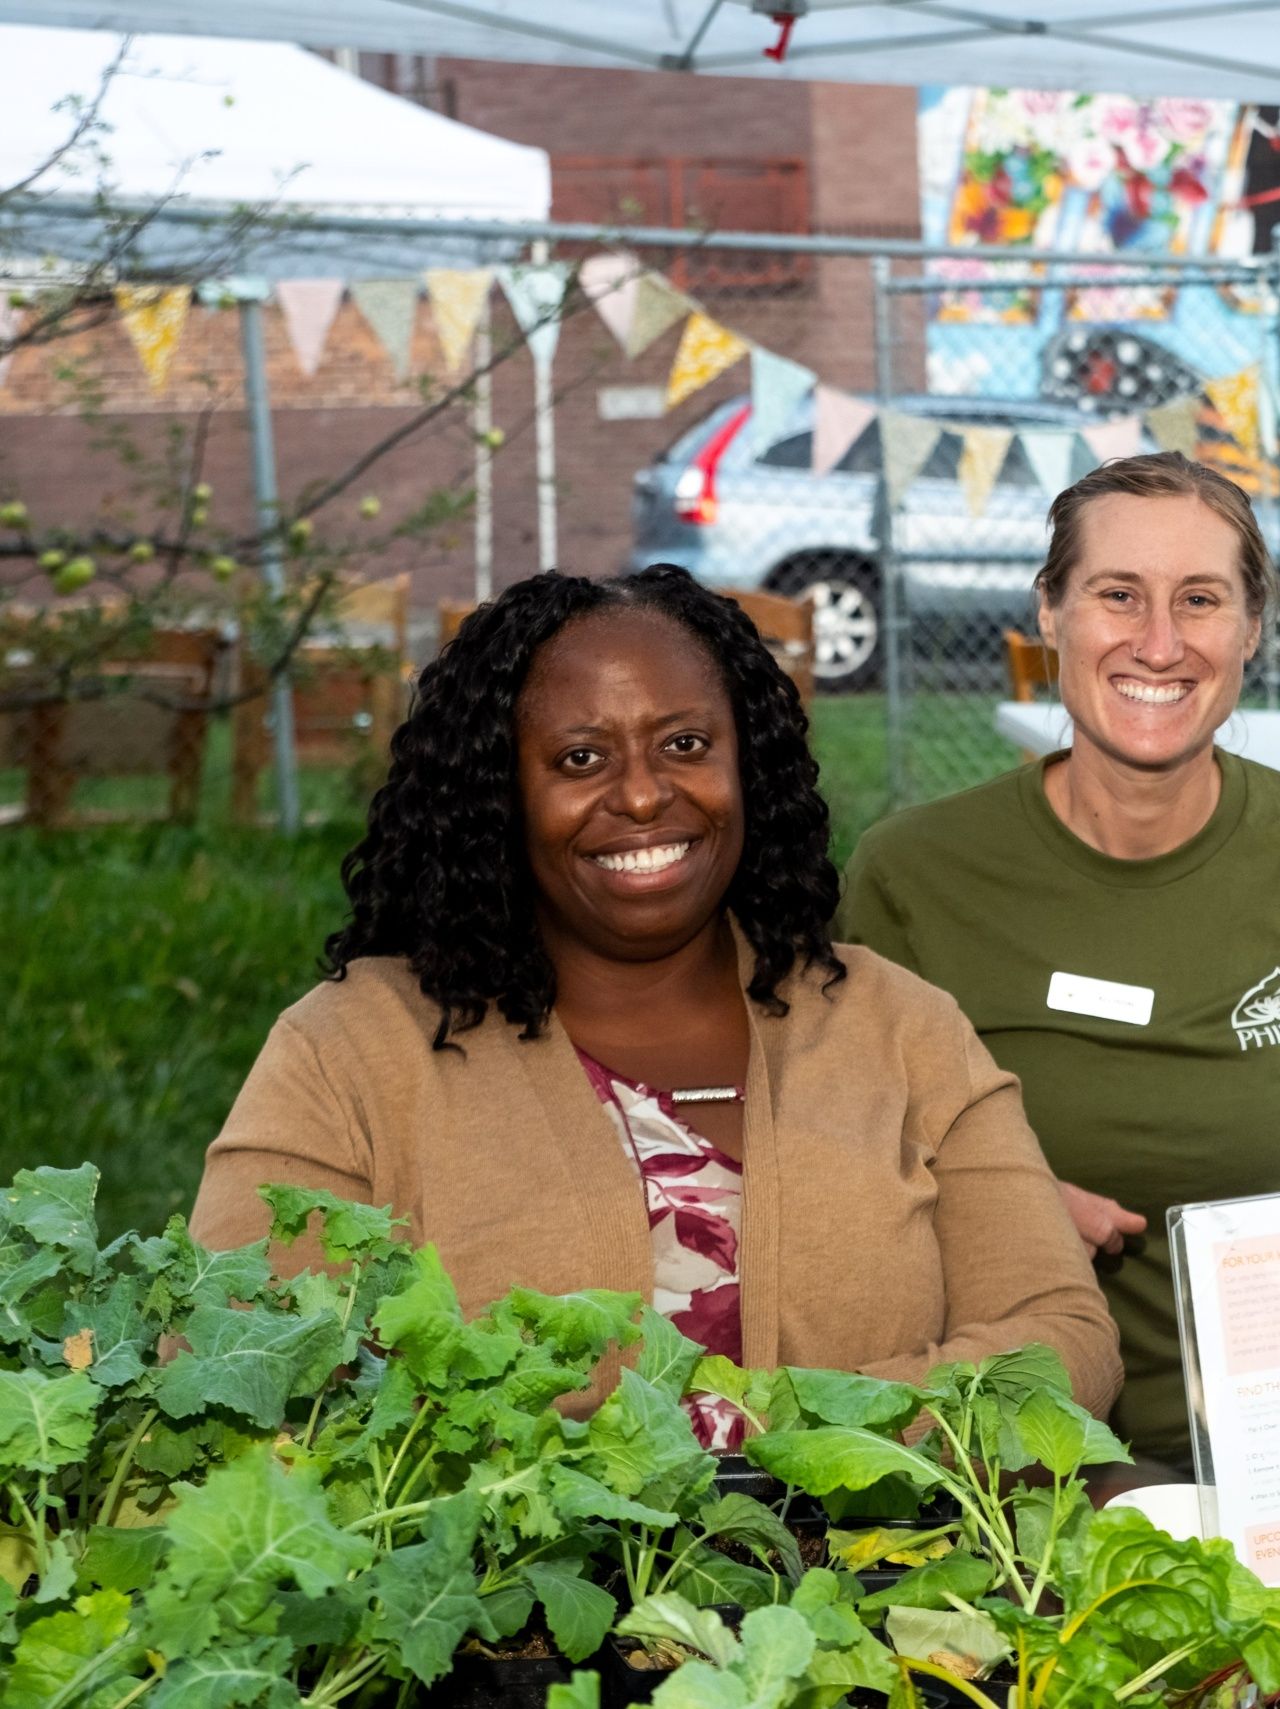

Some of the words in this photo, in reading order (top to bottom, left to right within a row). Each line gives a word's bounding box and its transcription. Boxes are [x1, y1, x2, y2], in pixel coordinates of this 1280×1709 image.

[1223, 1256, 1244, 1268] FOR
[1247, 1252, 1274, 1265] YOUR
[1237, 1385, 1263, 1397] FIND
